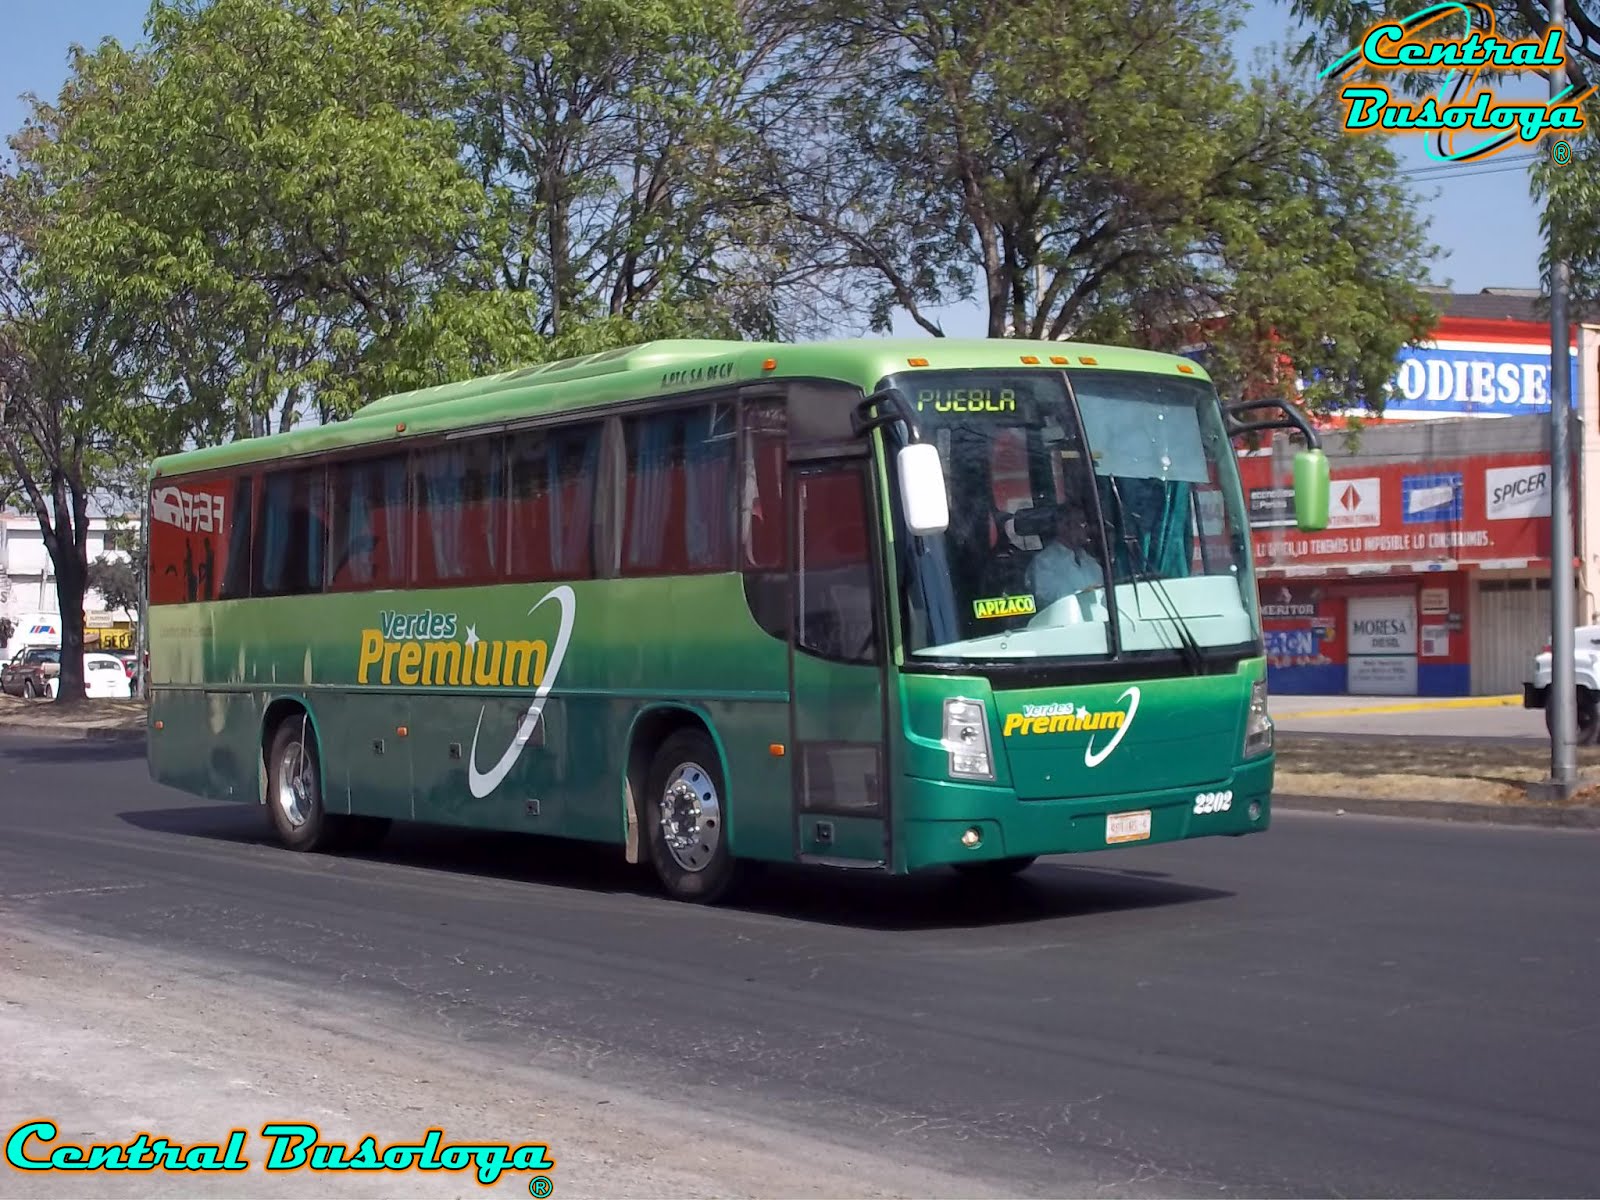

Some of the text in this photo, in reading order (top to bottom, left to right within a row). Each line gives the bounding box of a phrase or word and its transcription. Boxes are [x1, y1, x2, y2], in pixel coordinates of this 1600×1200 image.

[1396, 358, 1551, 405] ODIESE
[917, 388, 1016, 411] PUEBLA
[1493, 472, 1547, 504] SPICER
[1413, 533, 1426, 549] LO
[978, 598, 1034, 615] APIZACO
[1261, 604, 1315, 616] MERITOR
[380, 608, 459, 640] Verdes
[1353, 619, 1407, 636] MORESA
[358, 629, 548, 687] Premium
[1022, 703, 1074, 718] Verdes
[1003, 711, 1126, 737] Premium
[1192, 789, 1233, 815] 2202
